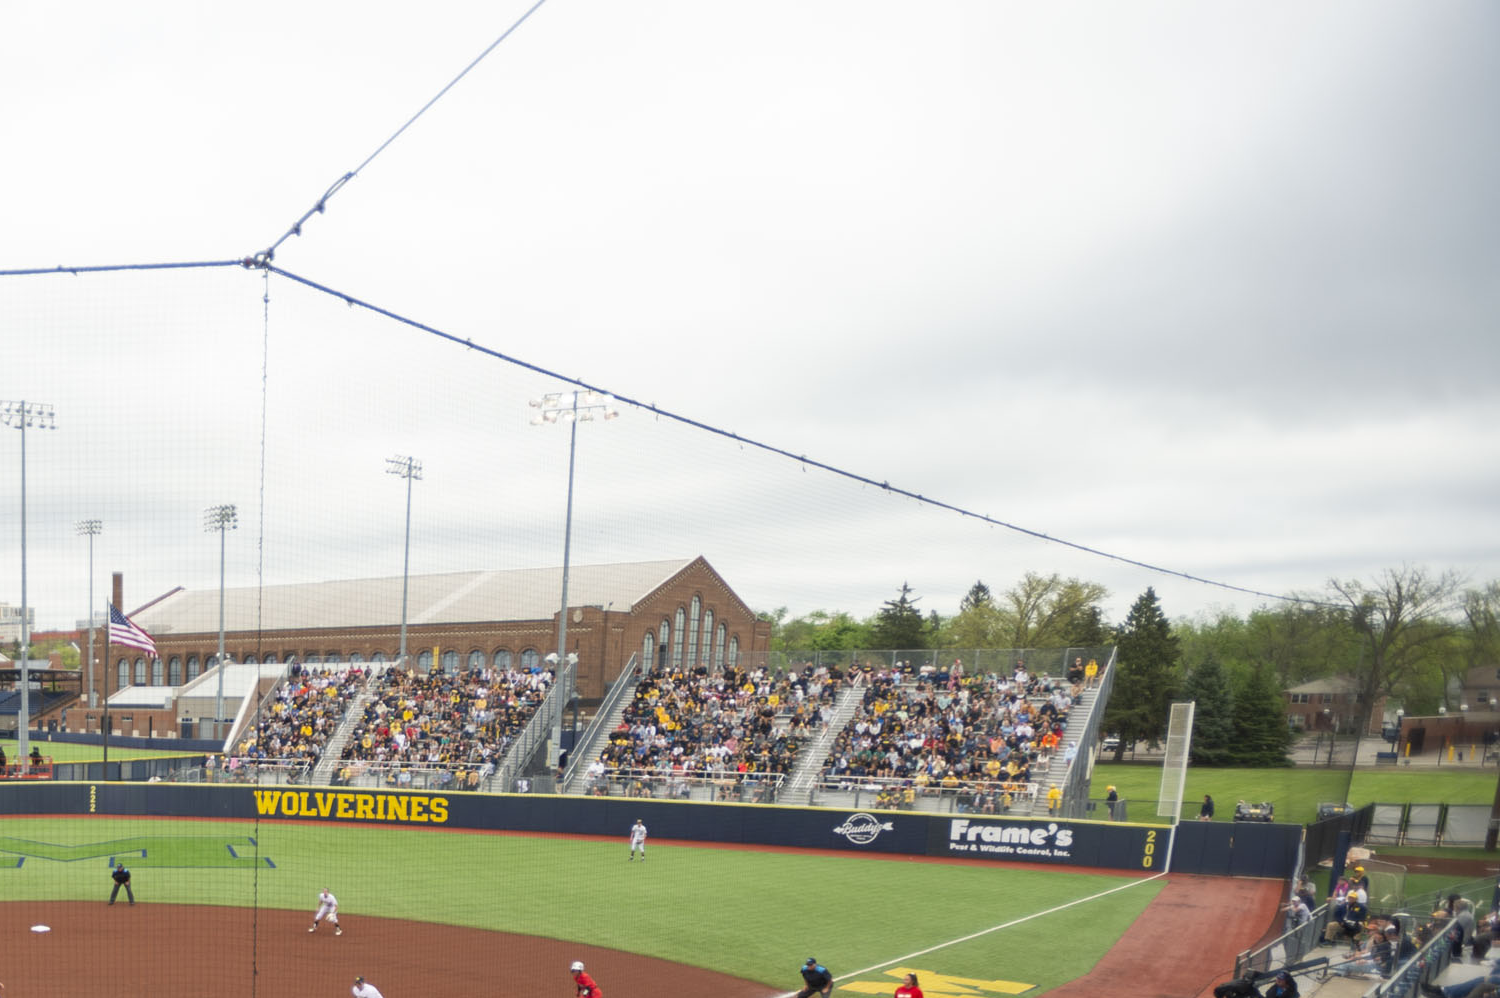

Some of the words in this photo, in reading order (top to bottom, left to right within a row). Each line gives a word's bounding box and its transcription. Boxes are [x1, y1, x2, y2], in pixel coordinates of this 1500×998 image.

[254, 790, 448, 823] WOLVERINES
[950, 819, 1073, 847] Frame's
[950, 843, 968, 851] Pest
[980, 845, 1014, 854] Wildlife
[1016, 847, 1052, 856] Control,
[1143, 831, 1156, 867] 200
